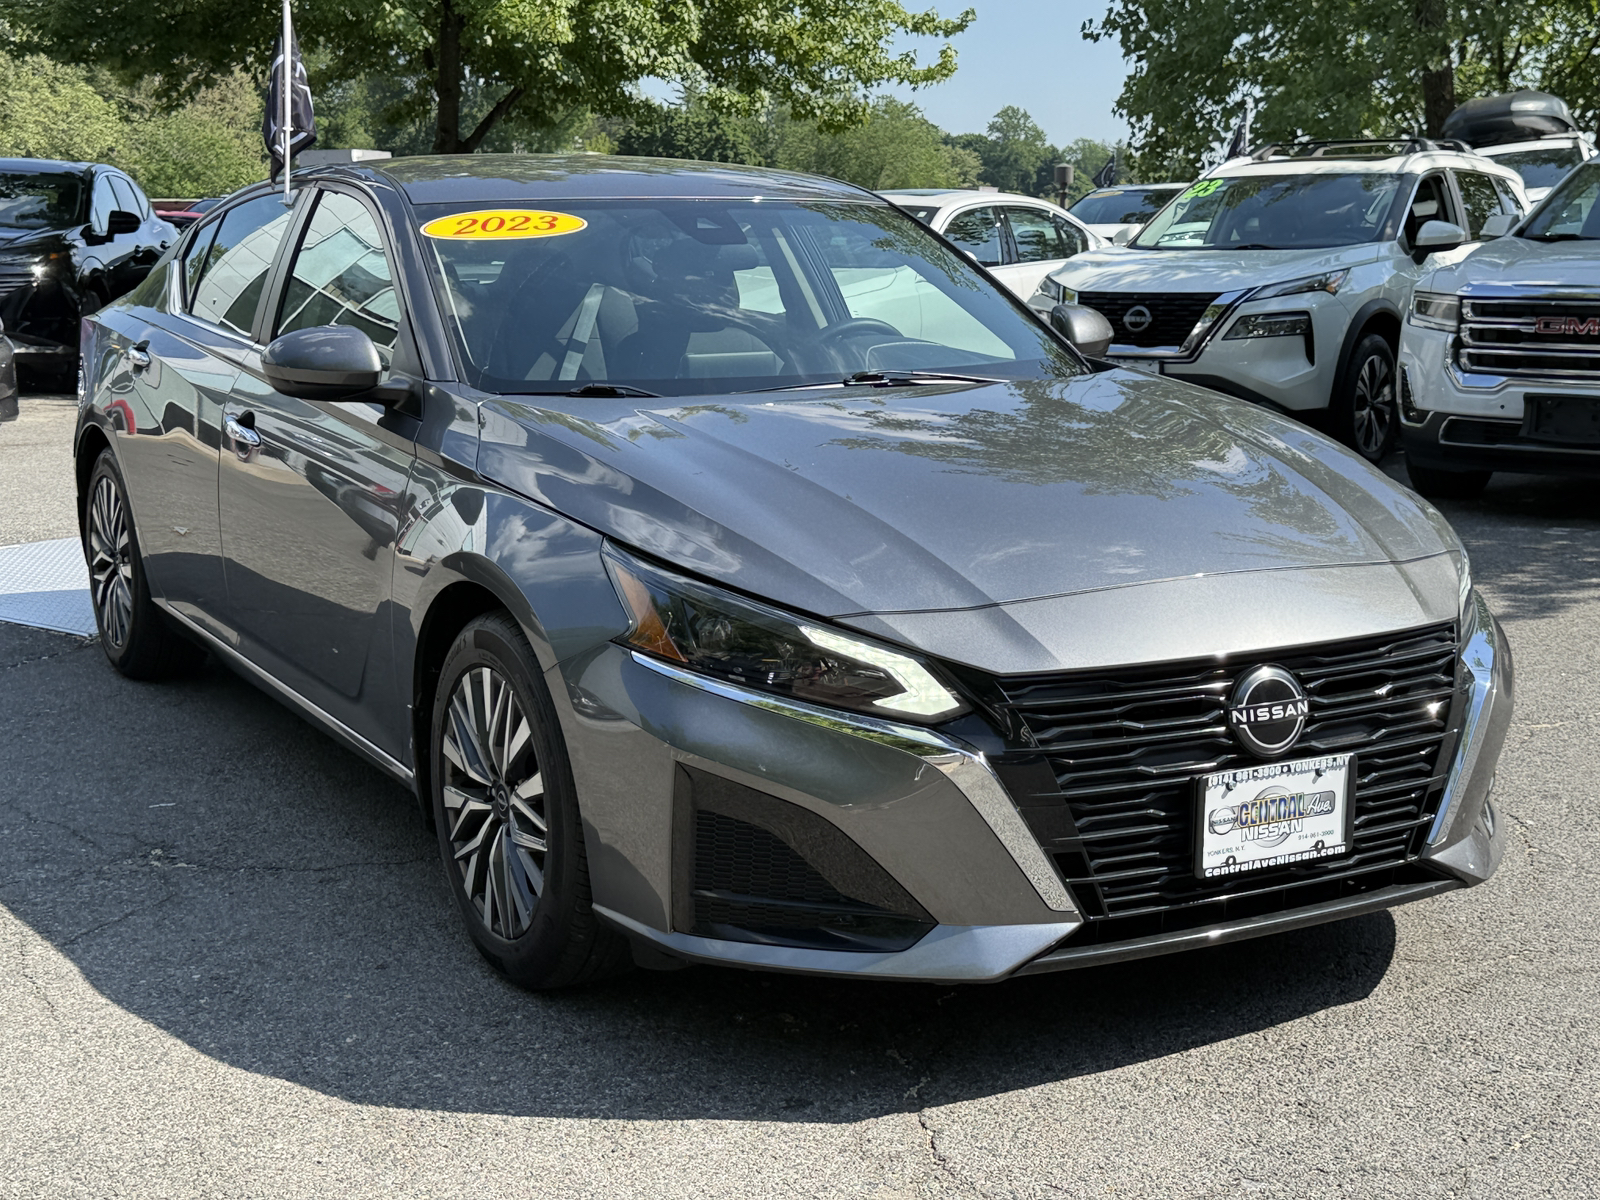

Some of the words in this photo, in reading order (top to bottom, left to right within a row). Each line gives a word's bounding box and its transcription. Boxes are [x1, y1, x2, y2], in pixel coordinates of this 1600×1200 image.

[452, 215, 559, 236] 2023
[1536, 316, 1600, 335] GM
[1231, 700, 1309, 724] NISSAN
[1239, 793, 1305, 827] CENTRAL
[1306, 793, 1333, 815] Ave.
[1241, 818, 1303, 842] NISSAN
[1205, 845, 1346, 877] CentralAveNissan.com
